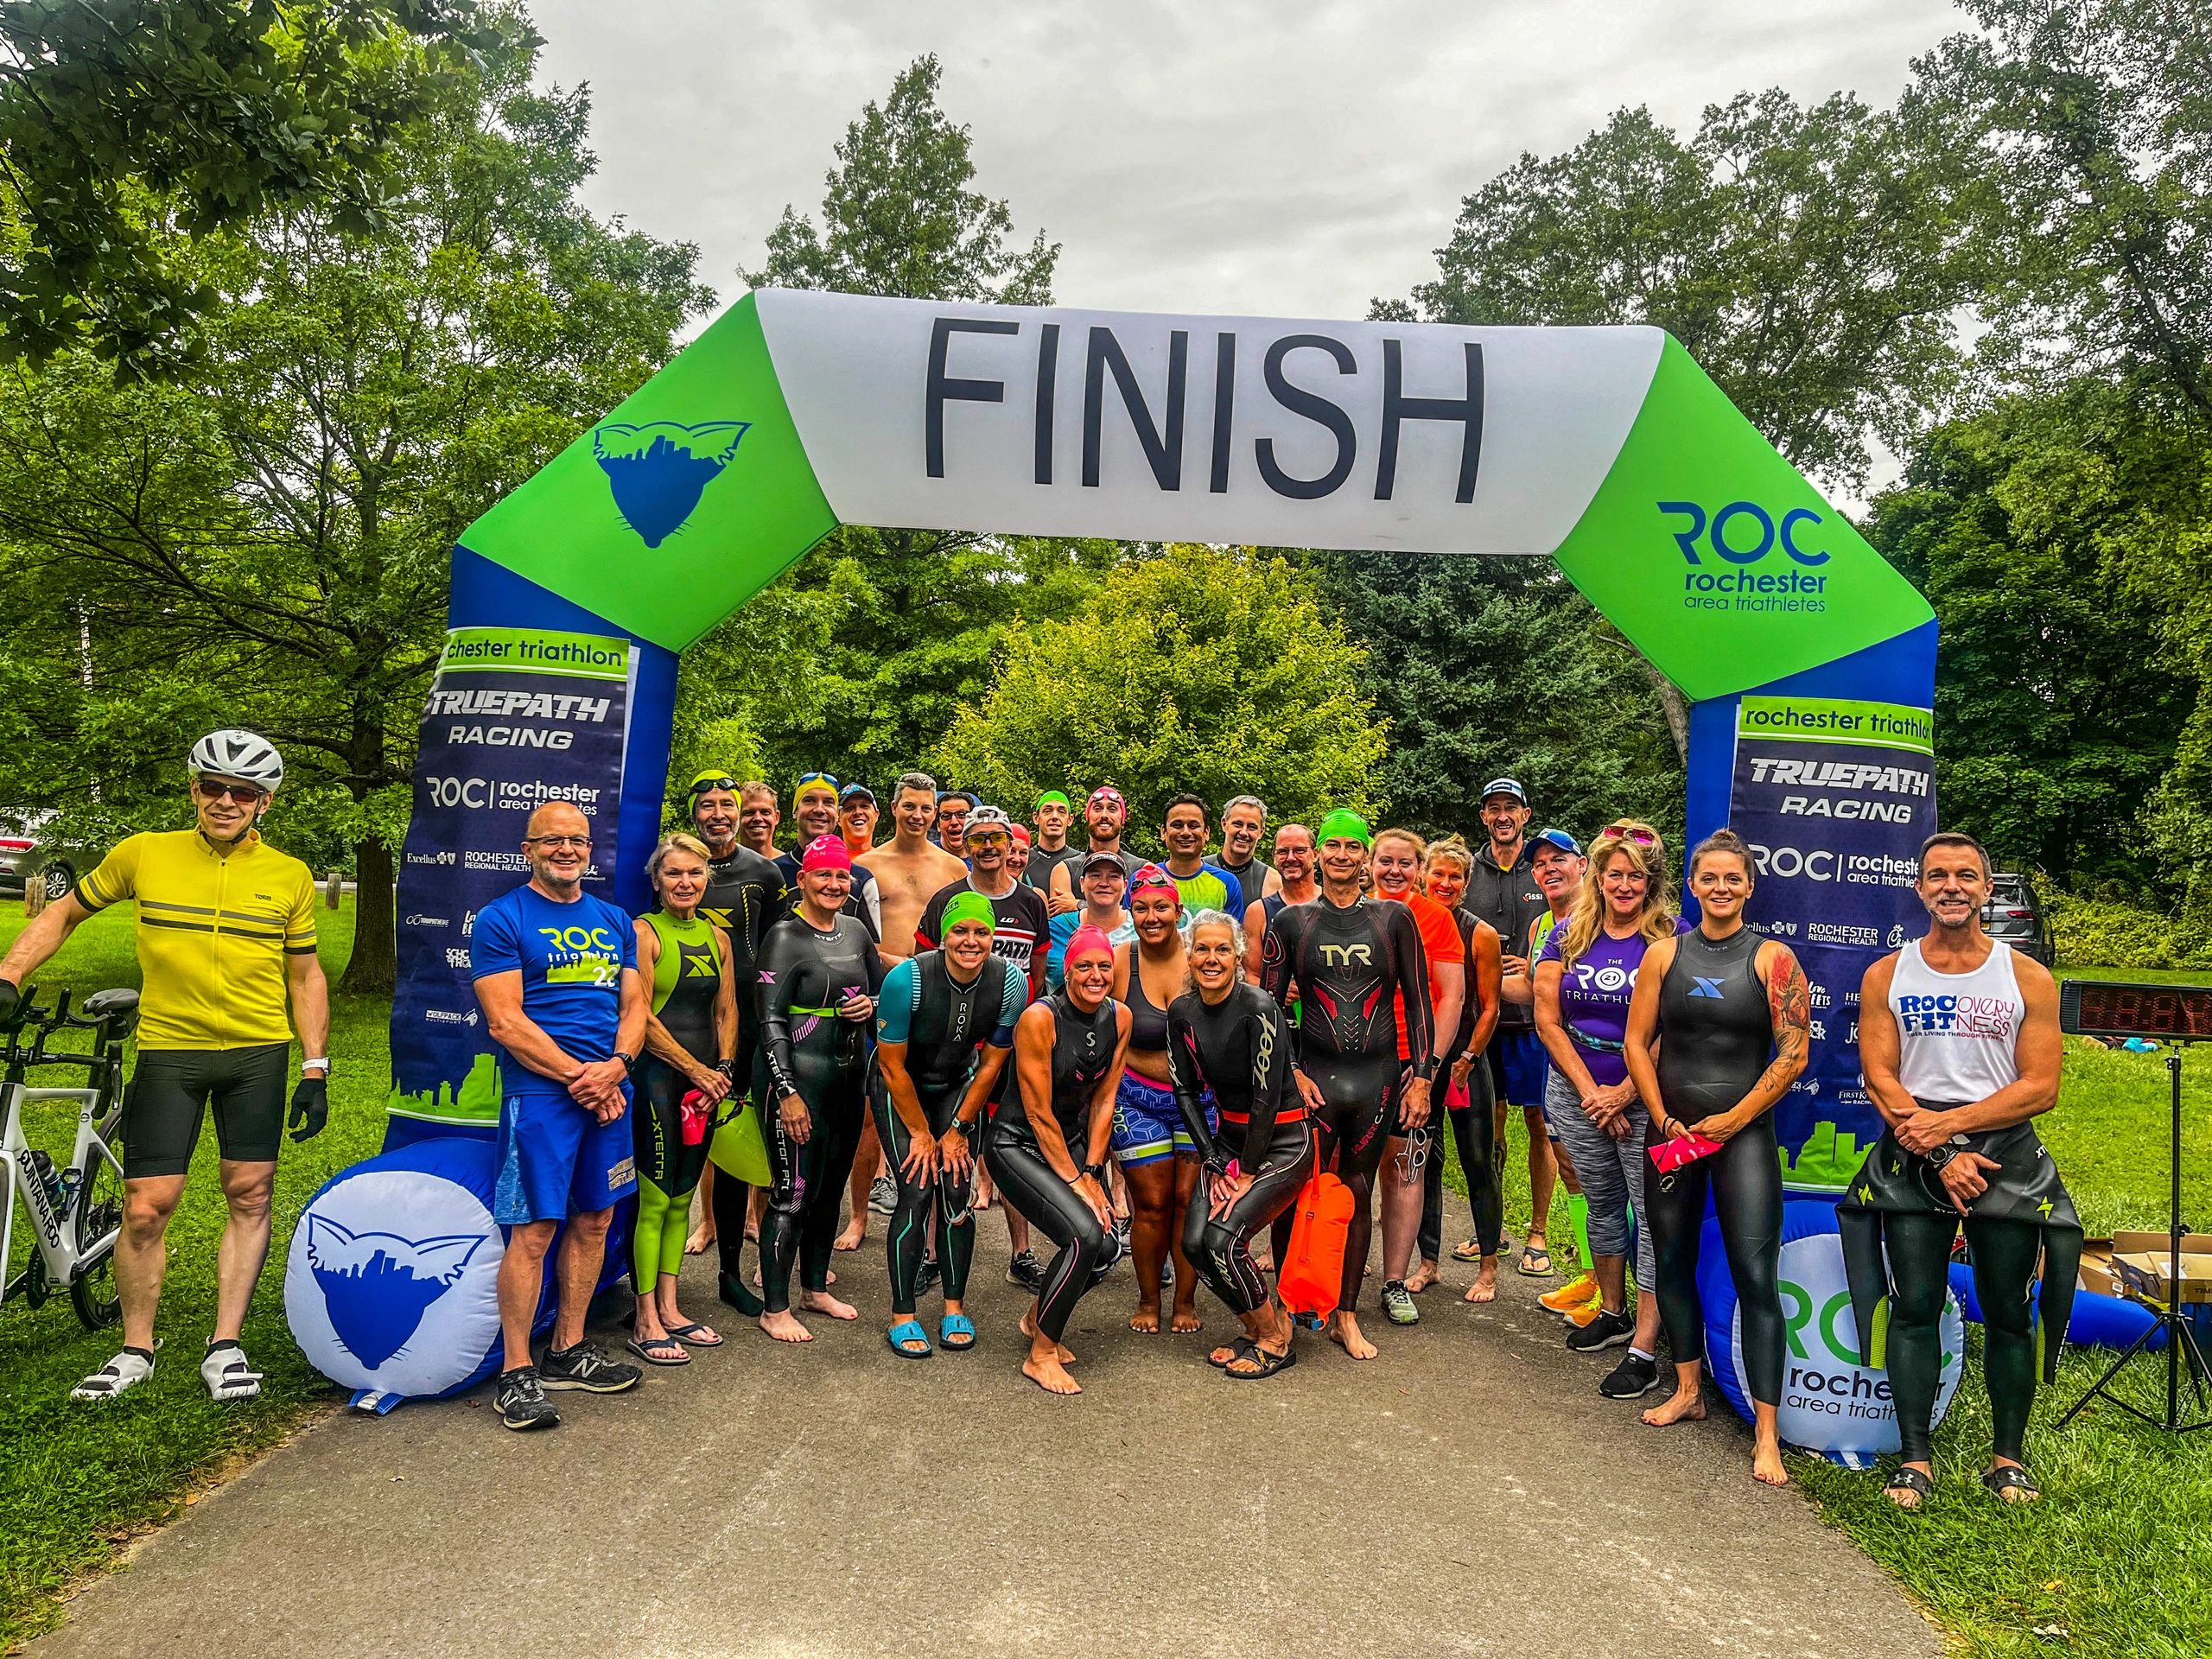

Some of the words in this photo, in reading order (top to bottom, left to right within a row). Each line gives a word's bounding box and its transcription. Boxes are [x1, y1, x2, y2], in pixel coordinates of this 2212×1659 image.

[925, 317, 1484, 505] FINISH
[1656, 500, 1832, 567] ROC
[1685, 569, 1827, 594] rochester
[1684, 596, 1729, 610] area
[1735, 595, 1826, 613] triathletes
[519, 639, 622, 667] triathlon
[429, 690, 612, 723] TRUEPATH
[1745, 707, 1864, 731] rochester
[448, 725, 575, 750] RACING
[1749, 758, 1929, 798] TRUEPATH
[425, 776, 487, 810] ROC
[499, 780, 601, 803] rochester
[499, 799, 531, 810] area
[1779, 795, 1912, 824] RACING
[407, 852, 437, 864] Excellus
[464, 861, 500, 871] REGIONAL
[501, 863, 531, 873] HEALTH
[1746, 843, 1834, 881] ROC
[1847, 873, 1878, 884] area
[537, 926, 616, 951] ROC
[1808, 923, 1878, 939] ROCHESTER
[1808, 933, 1848, 944] REGIONAL
[1848, 936, 1878, 946] HEALTH
[1319, 943, 1373, 967] TYR
[1565, 990, 1631, 1004] TRIATHL
[427, 1010, 461, 1020] WOLFPACK
[652, 1121, 664, 1180] XTERRA
[17, 1149, 49, 1224] QUINTANA
[1787, 1395, 1841, 1414] area
